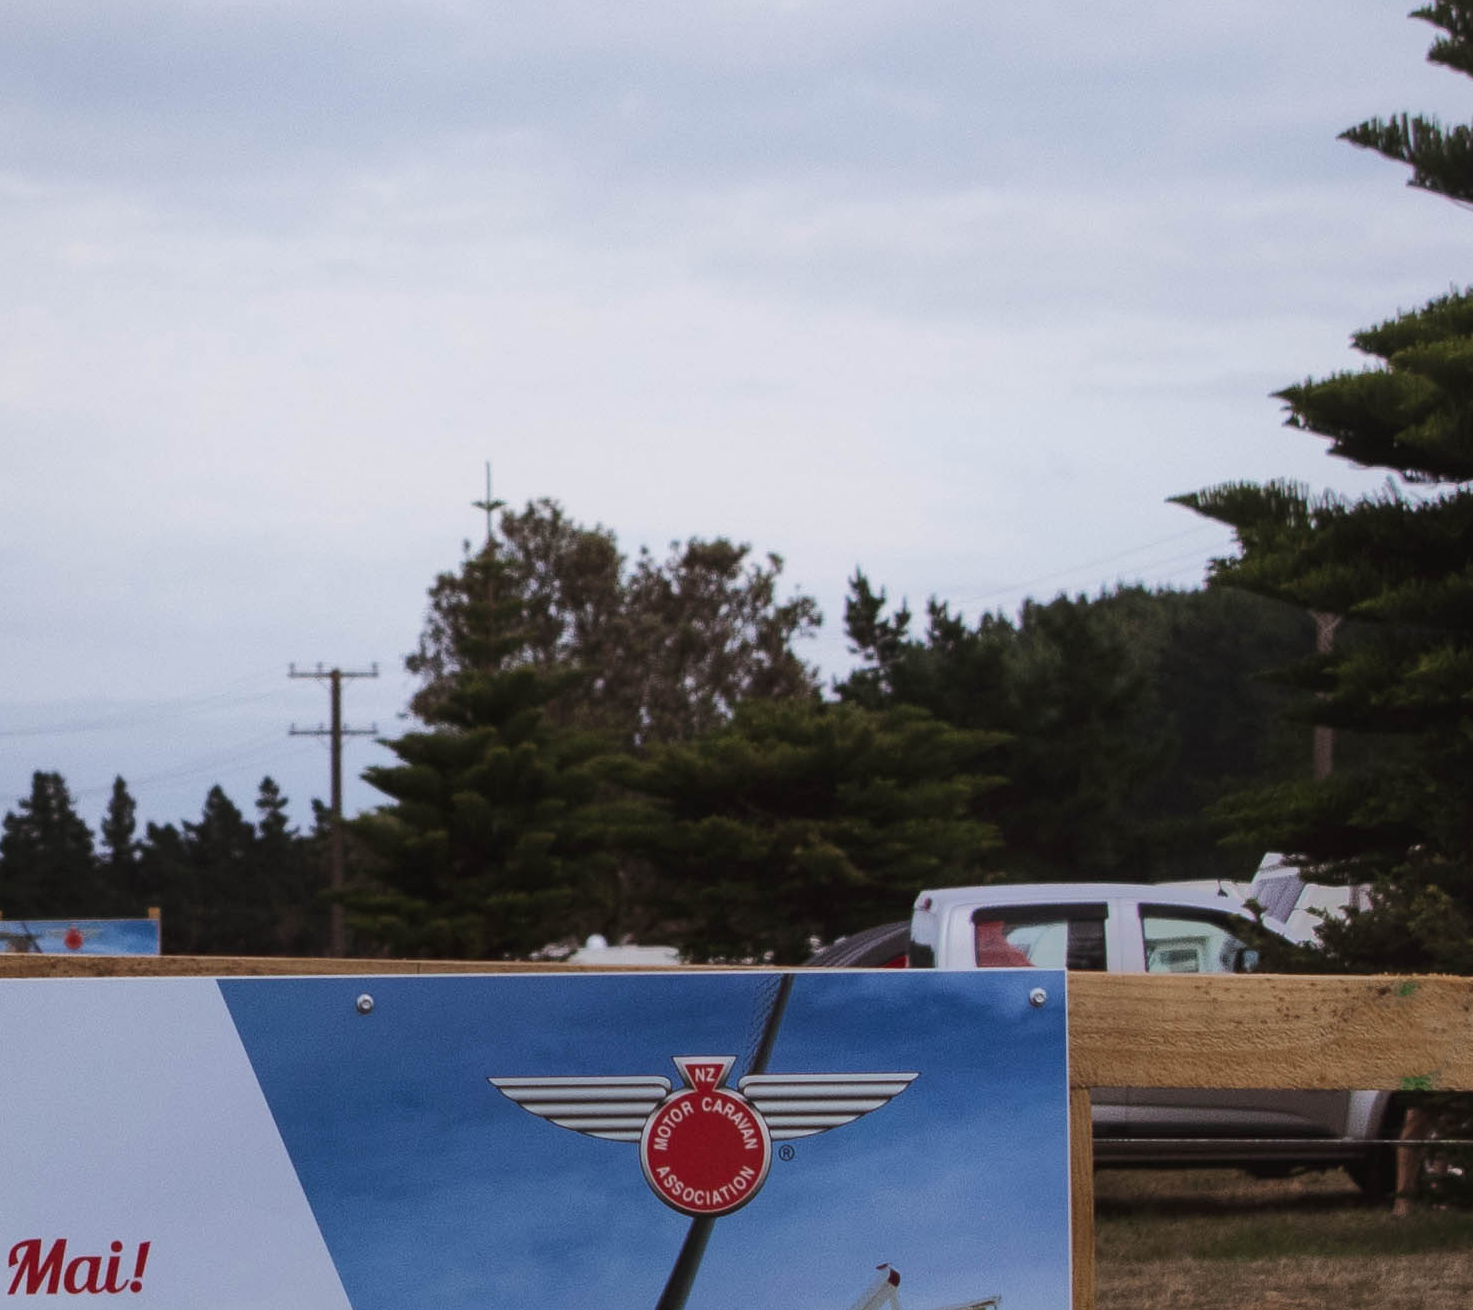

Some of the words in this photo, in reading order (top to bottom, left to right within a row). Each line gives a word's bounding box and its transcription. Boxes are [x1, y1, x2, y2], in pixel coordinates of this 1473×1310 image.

[695, 1067, 715, 1082] NZ
[654, 1101, 695, 1151] MOTOR
[701, 1097, 758, 1150] CARAVAN
[656, 1165, 755, 1205] ASSOCIATION
[6, 1237, 152, 1296] Mai!
